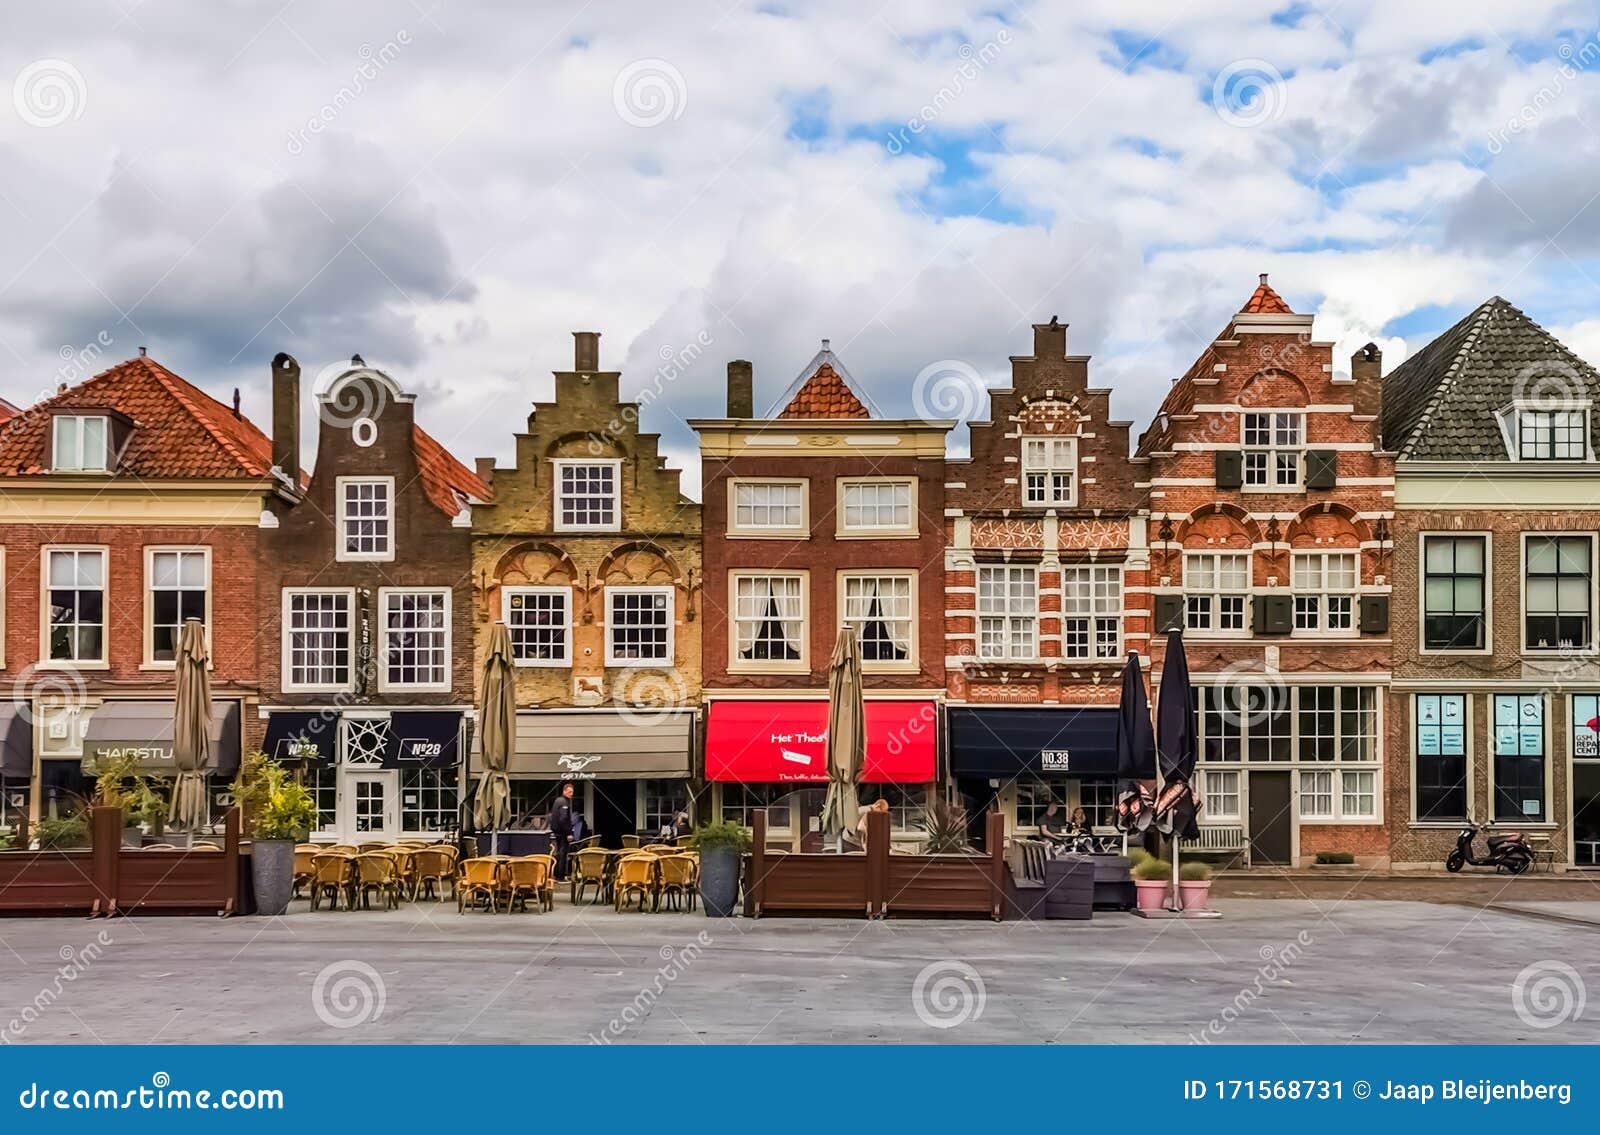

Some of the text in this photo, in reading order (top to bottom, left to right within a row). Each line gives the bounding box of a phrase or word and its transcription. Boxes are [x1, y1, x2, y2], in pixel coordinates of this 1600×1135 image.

[771, 734, 793, 743] Het
[97, 747, 174, 759] HAIRSTU
[1042, 752, 1069, 764] NO.38
